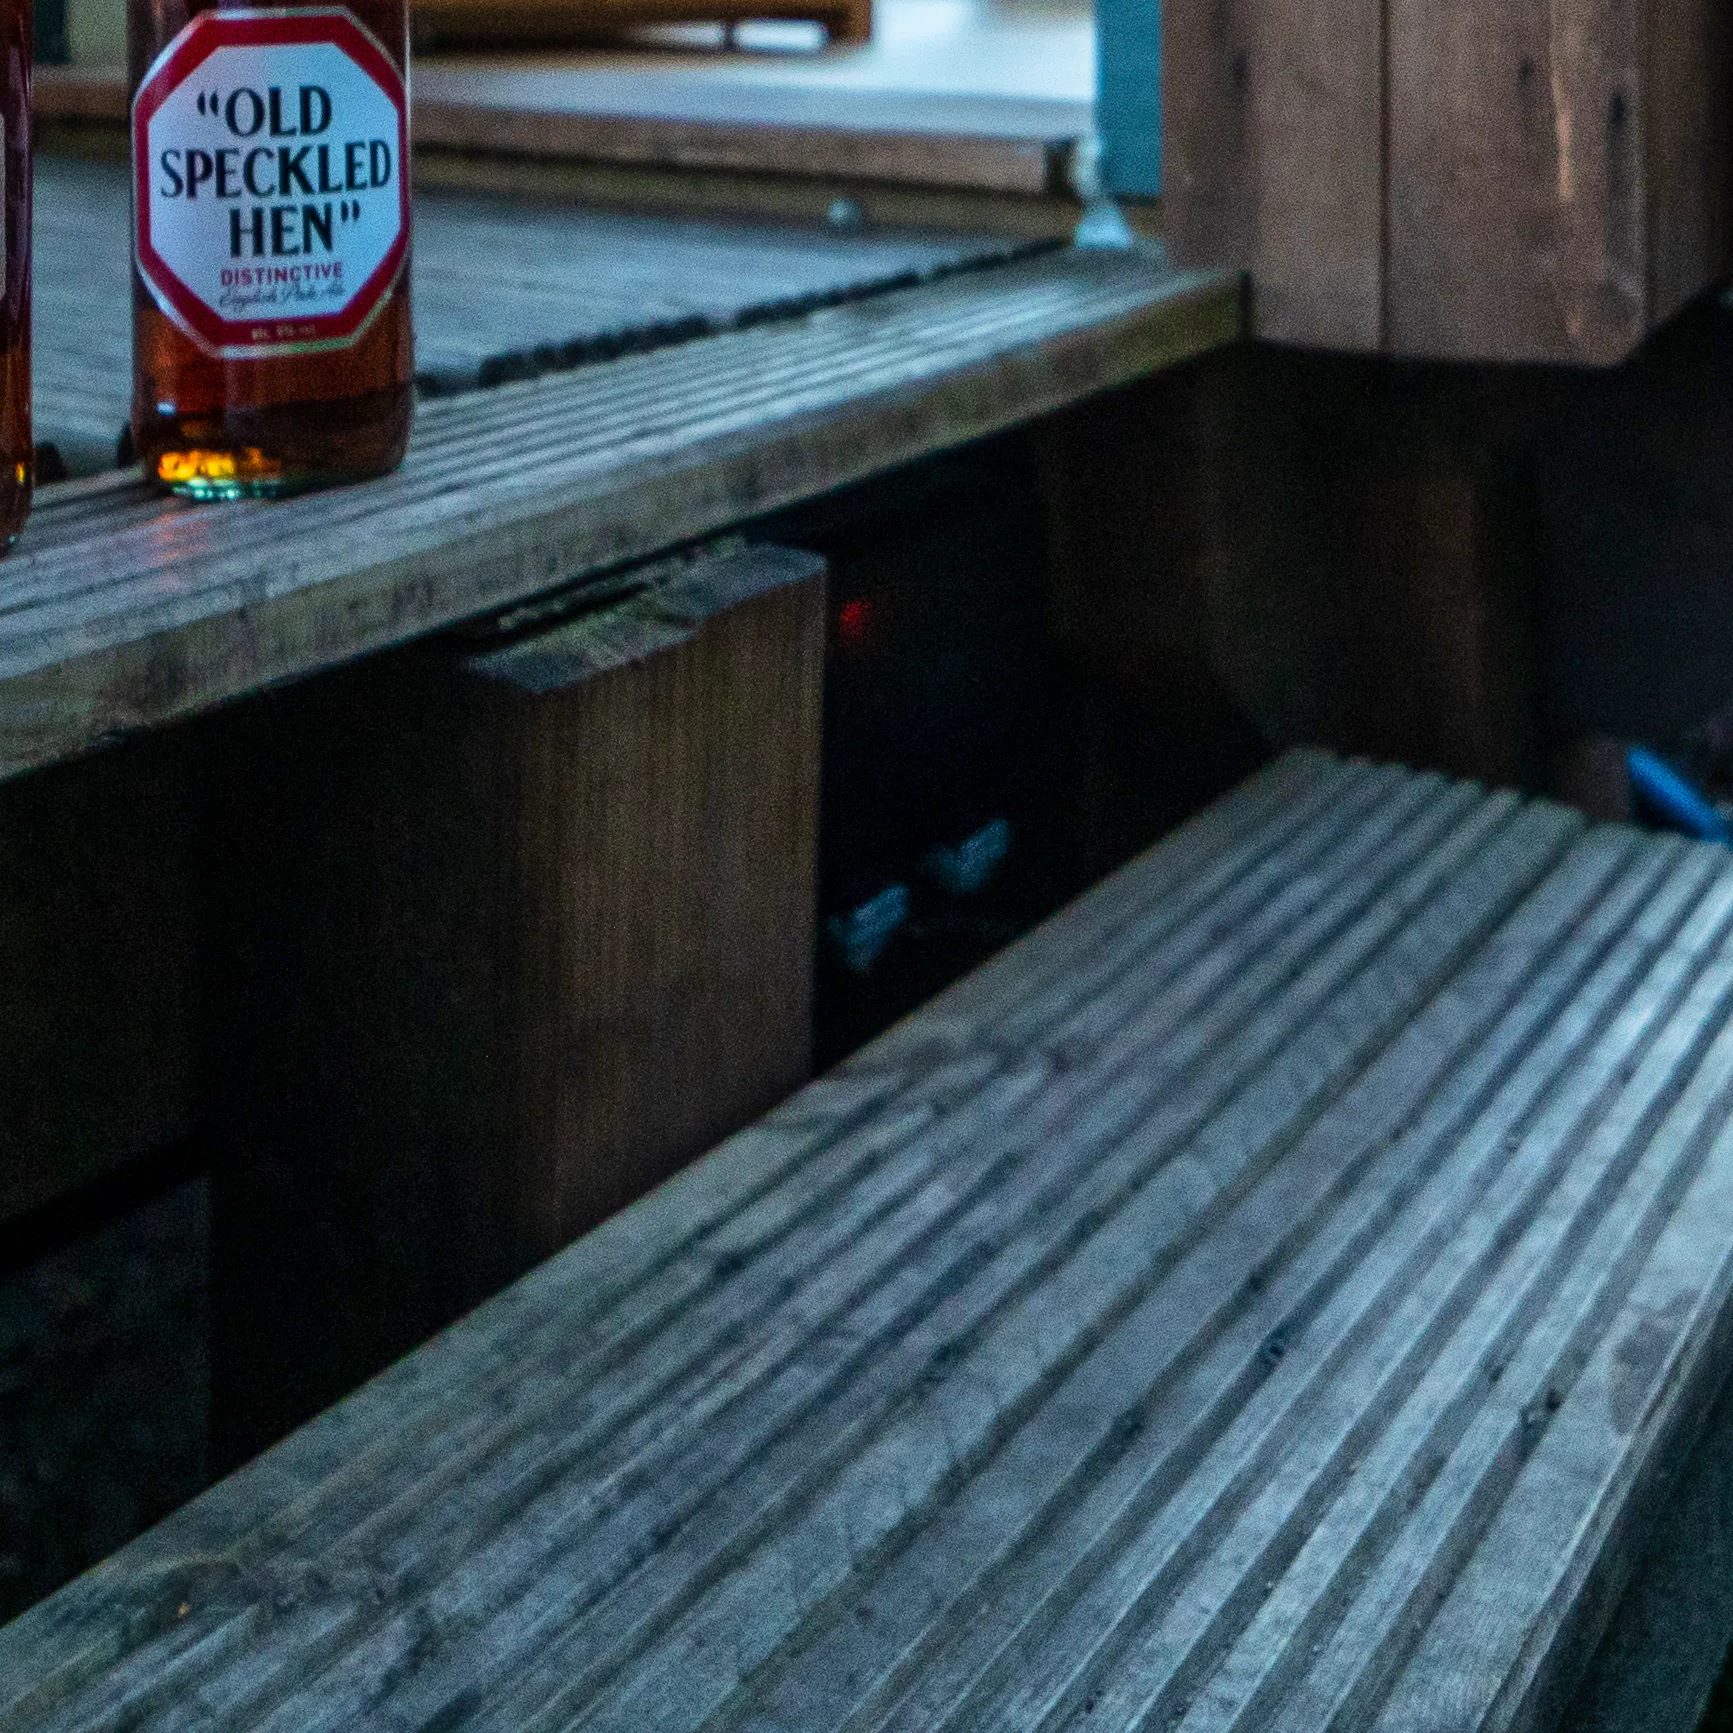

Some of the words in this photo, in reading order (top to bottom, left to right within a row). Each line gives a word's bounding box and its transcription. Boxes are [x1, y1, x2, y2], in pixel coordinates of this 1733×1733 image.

[197, 85, 332, 137] “OLD
[160, 139, 392, 200] SPECKLED
[229, 199, 361, 258] HEN”
[221, 262, 343, 286] DISTINCTIVE
